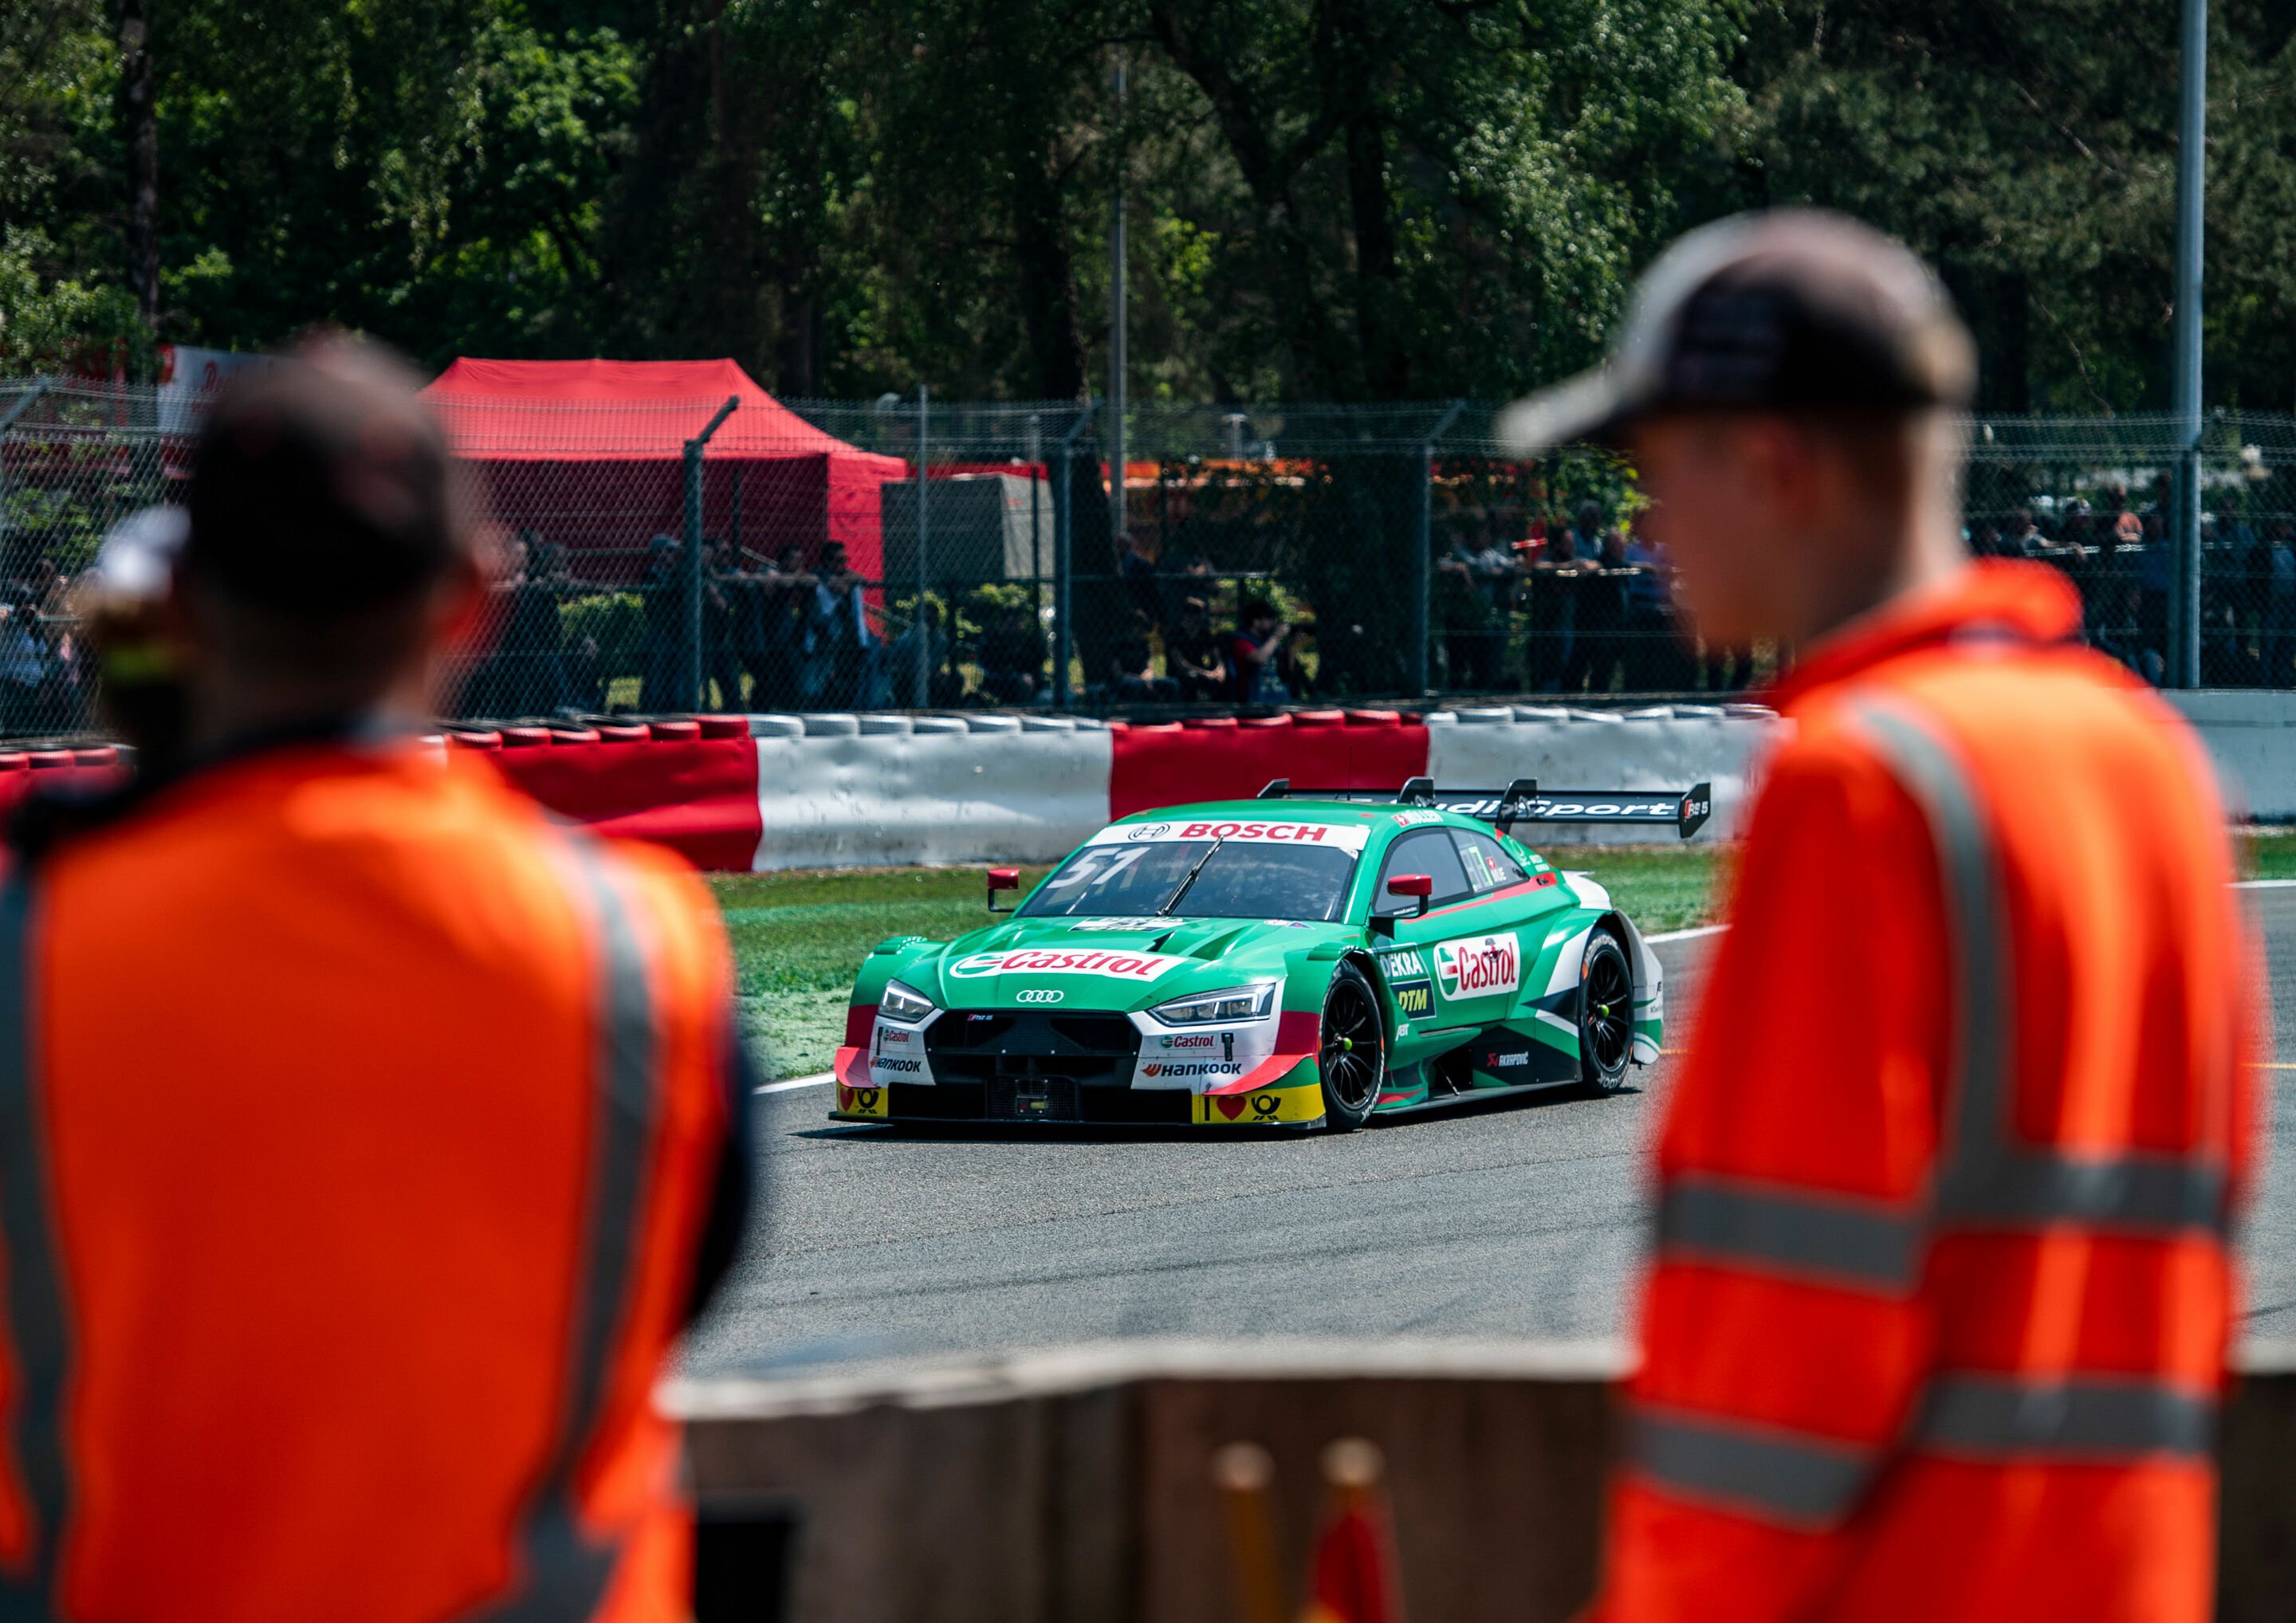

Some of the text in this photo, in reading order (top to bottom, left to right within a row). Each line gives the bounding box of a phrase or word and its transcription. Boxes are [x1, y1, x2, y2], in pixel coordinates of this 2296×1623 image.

[1519, 800, 1675, 816] Sport
[1700, 801, 1708, 814] 5
[1180, 823, 1327, 841] BOSCH
[1047, 847, 1151, 889] 51
[1001, 952, 1164, 975] Castrol
[1380, 951, 1423, 978] DEKRA
[1459, 942, 1516, 991] Castrol
[1398, 988, 1427, 1012] DTM
[889, 1030, 910, 1043] Castrol
[1174, 1035, 1214, 1048] Castrol
[1395, 1024, 1409, 1041] ABT
[1205, 1097, 1210, 1121] I
